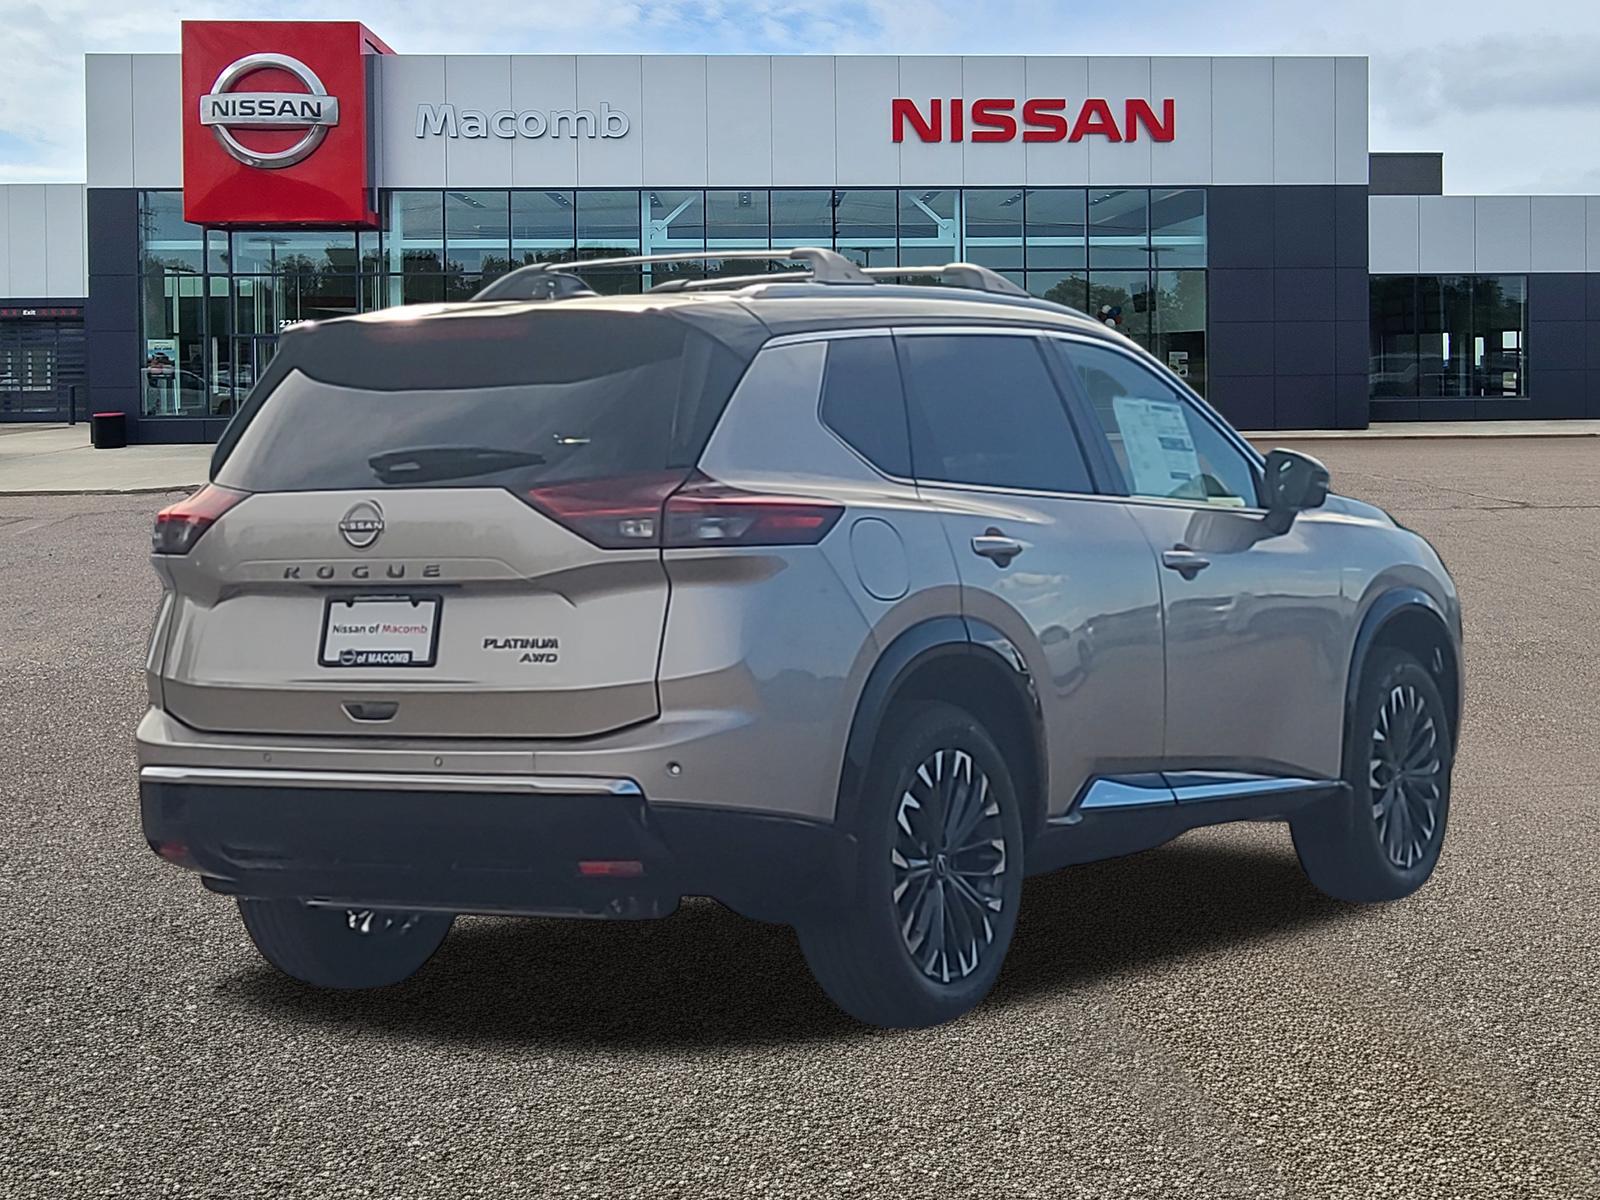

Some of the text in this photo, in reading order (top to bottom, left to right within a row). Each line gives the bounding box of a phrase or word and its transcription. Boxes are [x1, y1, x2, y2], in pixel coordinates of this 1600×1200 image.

[211, 99, 322, 118] NISSAN
[415, 101, 631, 138] Macomb
[891, 98, 1175, 143] NISSAN
[283, 564, 441, 580] ROGUE
[332, 623, 428, 634] Nissan of Macomb
[483, 637, 559, 649] PLATINUM
[356, 653, 366, 664] of
[367, 653, 410, 663] MACOMB
[519, 653, 558, 663] AWD
